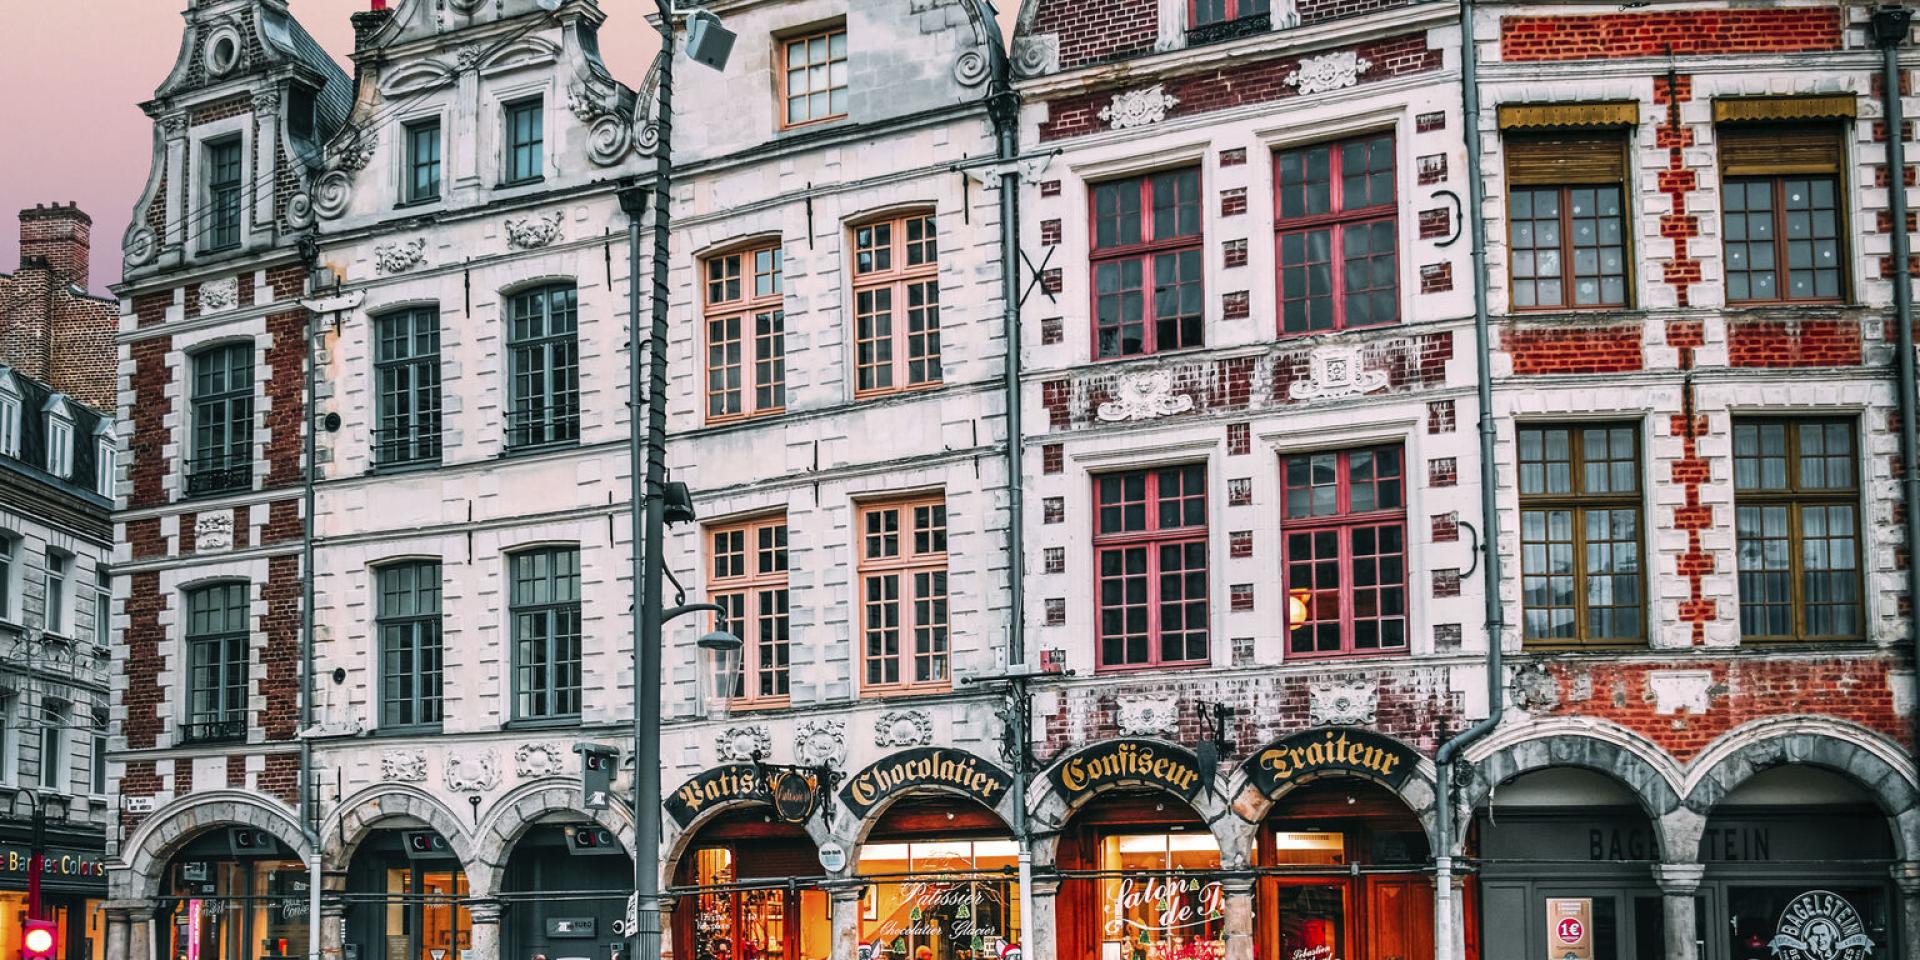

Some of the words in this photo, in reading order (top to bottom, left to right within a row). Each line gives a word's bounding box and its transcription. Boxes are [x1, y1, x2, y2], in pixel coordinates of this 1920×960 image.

[1061, 743, 1199, 791] Confiseur
[1259, 731, 1399, 783] Traiteur
[851, 752, 1000, 806] Chocolatier
[414, 836, 445, 849] CIC
[577, 831, 611, 845] CIC
[1159, 896, 1193, 926] de
[1781, 894, 1861, 937] BAGELSTEIN
[948, 919, 996, 939] Glacier
[1561, 923, 1580, 936] 1€
